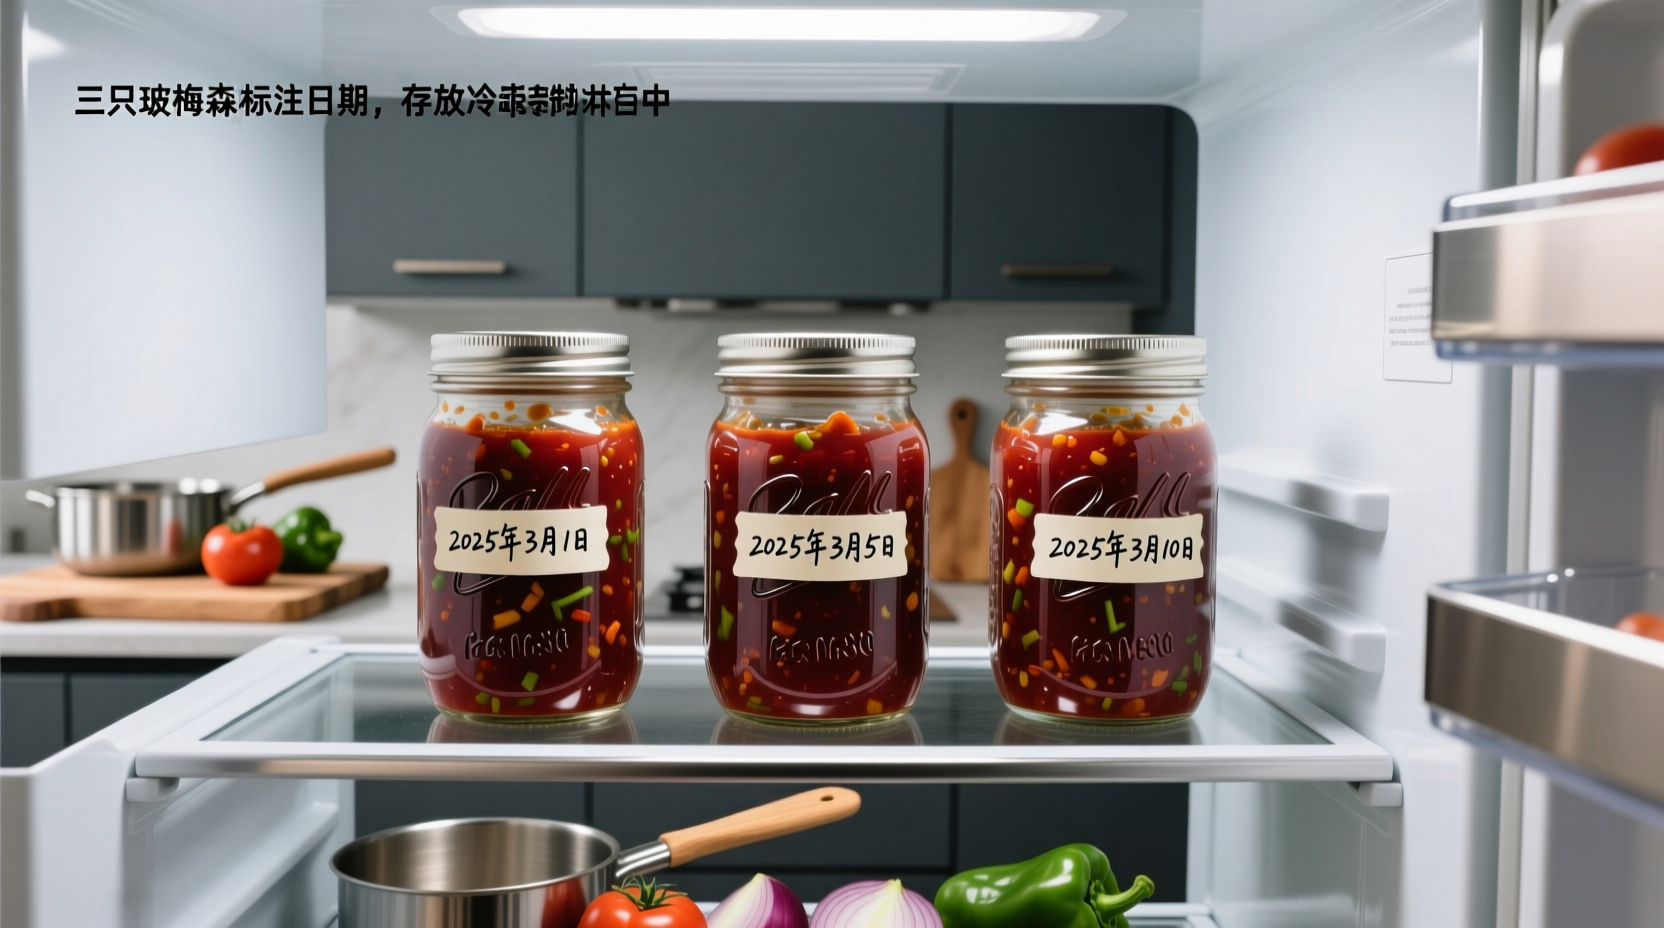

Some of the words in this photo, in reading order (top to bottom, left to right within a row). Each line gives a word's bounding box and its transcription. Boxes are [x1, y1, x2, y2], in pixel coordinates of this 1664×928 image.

[449, 523, 588, 562] 2025年3月1日
[749, 529, 894, 567] 2025年3月5日
[1049, 530, 1193, 569] 2025年3月10日
